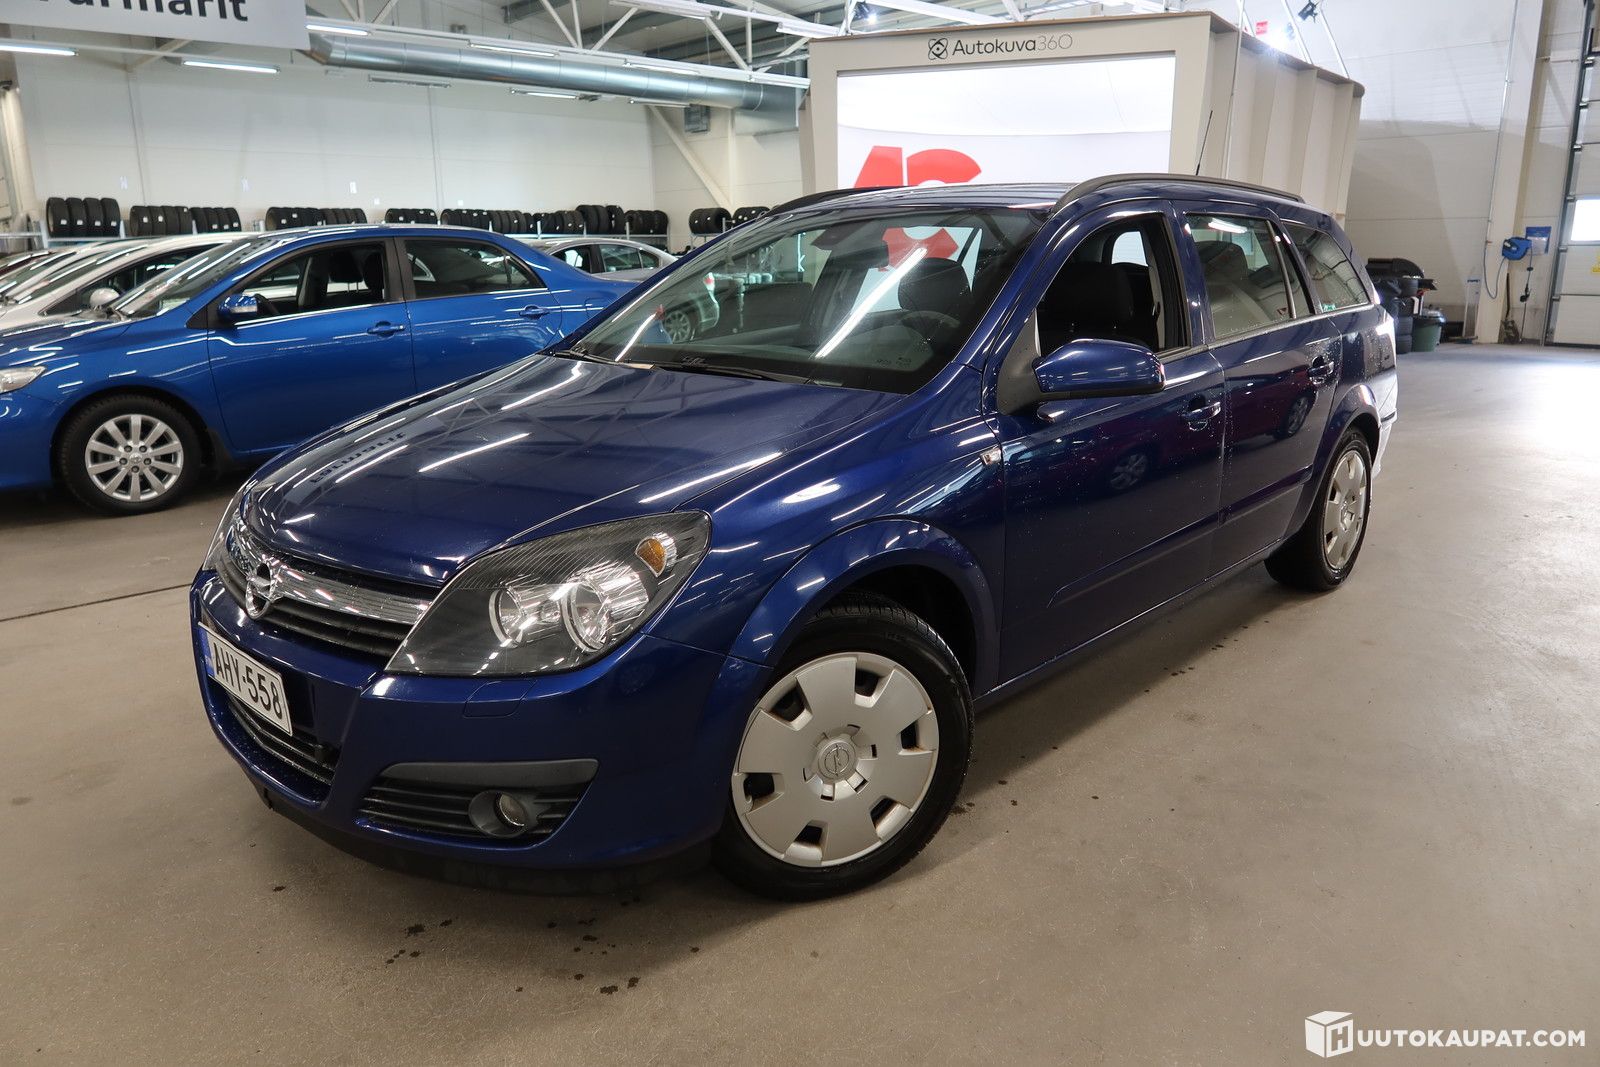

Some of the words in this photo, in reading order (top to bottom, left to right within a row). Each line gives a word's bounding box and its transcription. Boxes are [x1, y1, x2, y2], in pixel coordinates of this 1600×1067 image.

[40, 0, 248, 22] marit
[952, 34, 1073, 56] Autokuva360
[213, 642, 282, 720] AHY-558
